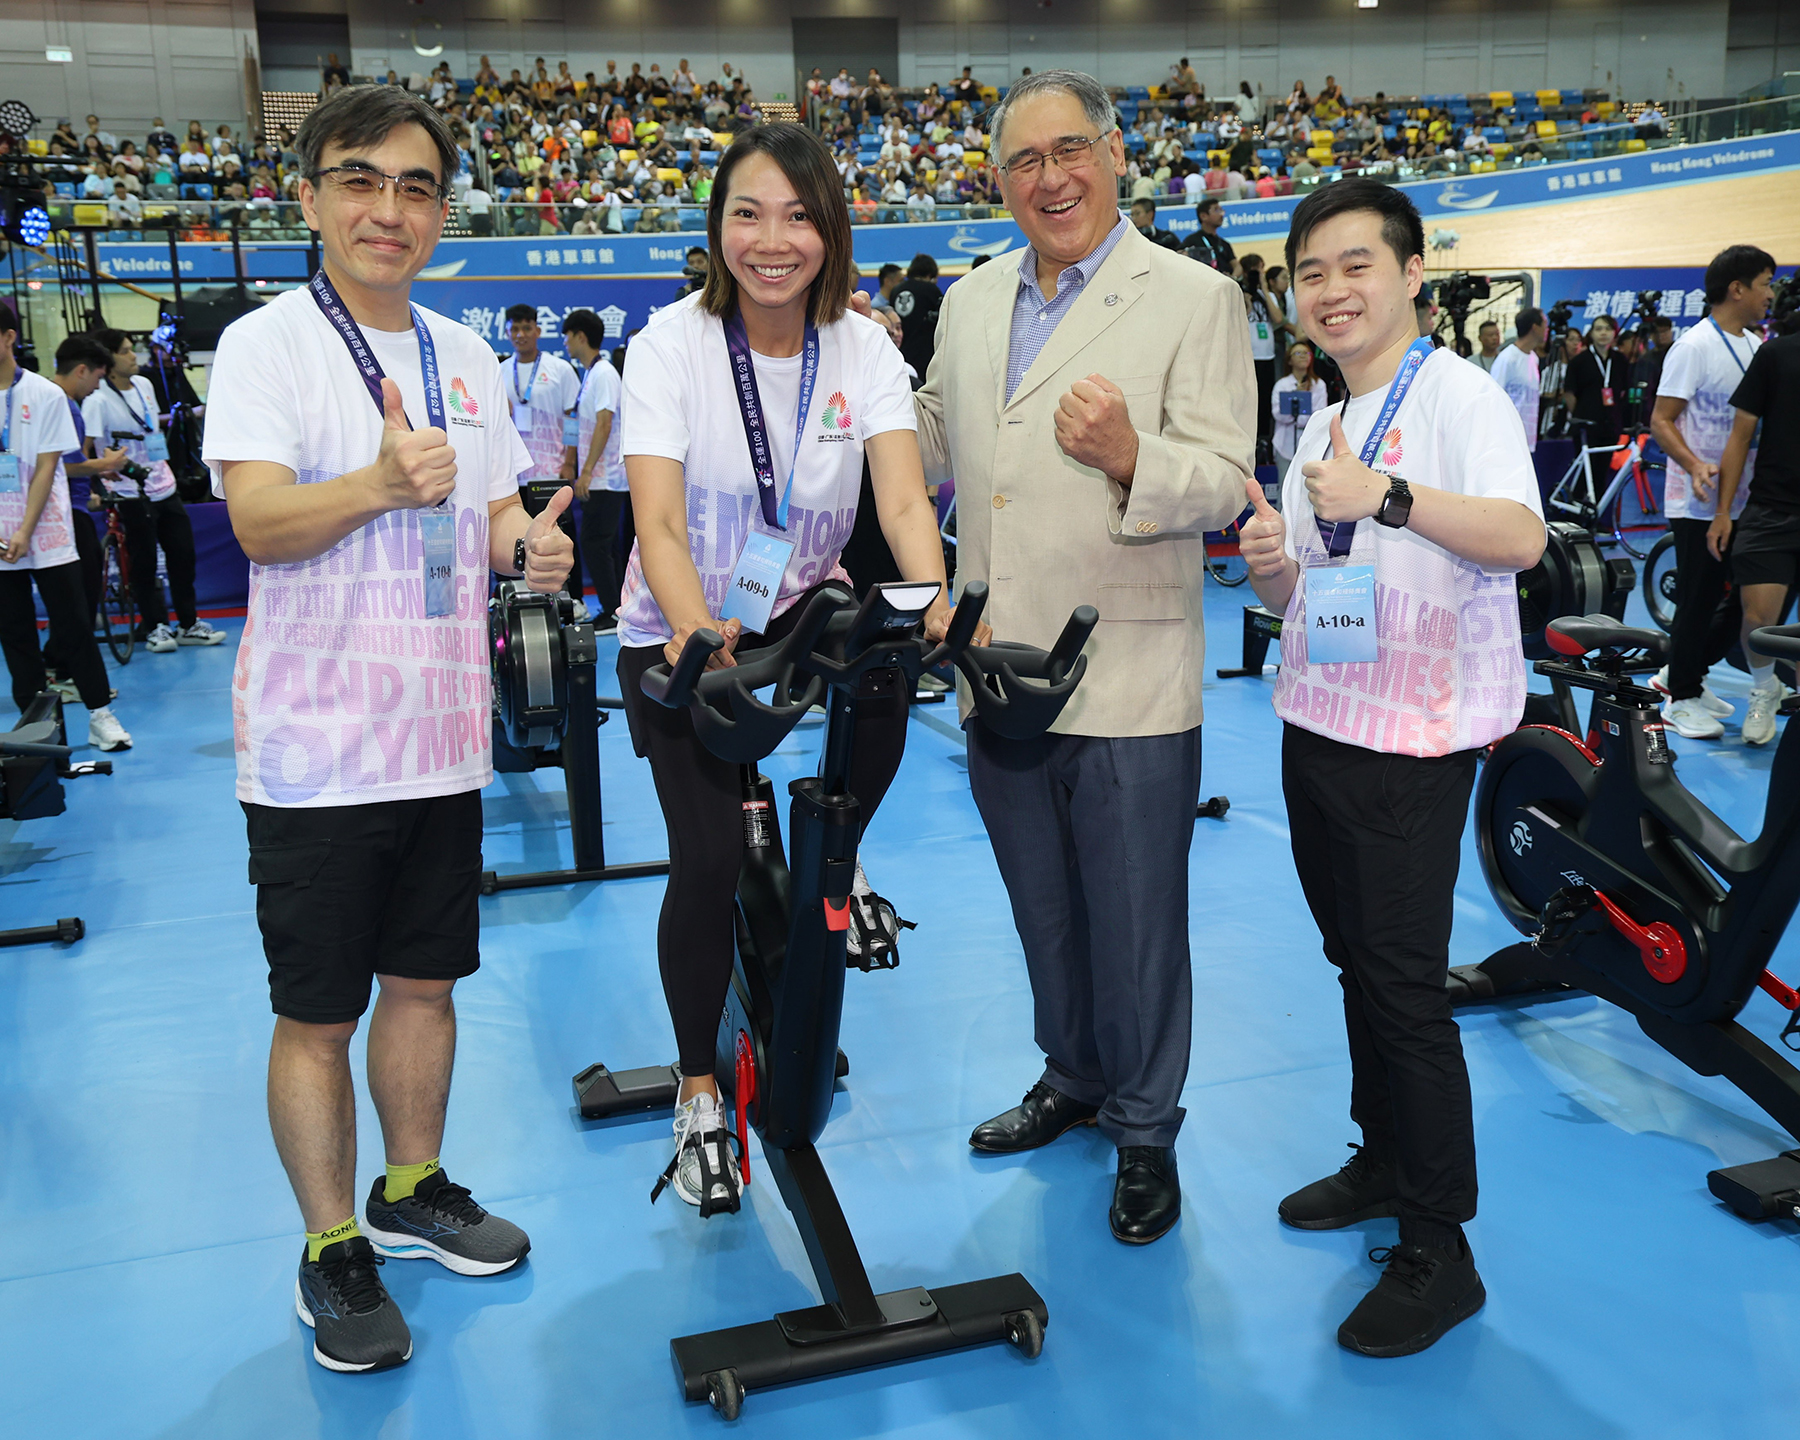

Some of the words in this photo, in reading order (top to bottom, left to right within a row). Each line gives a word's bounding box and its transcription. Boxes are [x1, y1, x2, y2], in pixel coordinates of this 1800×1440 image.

[1651, 161, 1682, 174] Hong
[1682, 156, 1713, 170] Kong
[1713, 148, 1775, 165] Velodrome
[1168, 218, 1199, 232] Hong
[1229, 211, 1290, 226] Velodrome
[526, 248, 615, 267] 香港單車館
[649, 247, 683, 261] Hong
[1583, 288, 1707, 319] 激情運會
[735, 576, 769, 598] A-09-b
[1316, 614, 1365, 629] A-10-a
[352, 623, 406, 657] WITH
[258, 650, 405, 717] AND
[419, 665, 459, 711] THE
[259, 705, 490, 805] OLYMPIC
